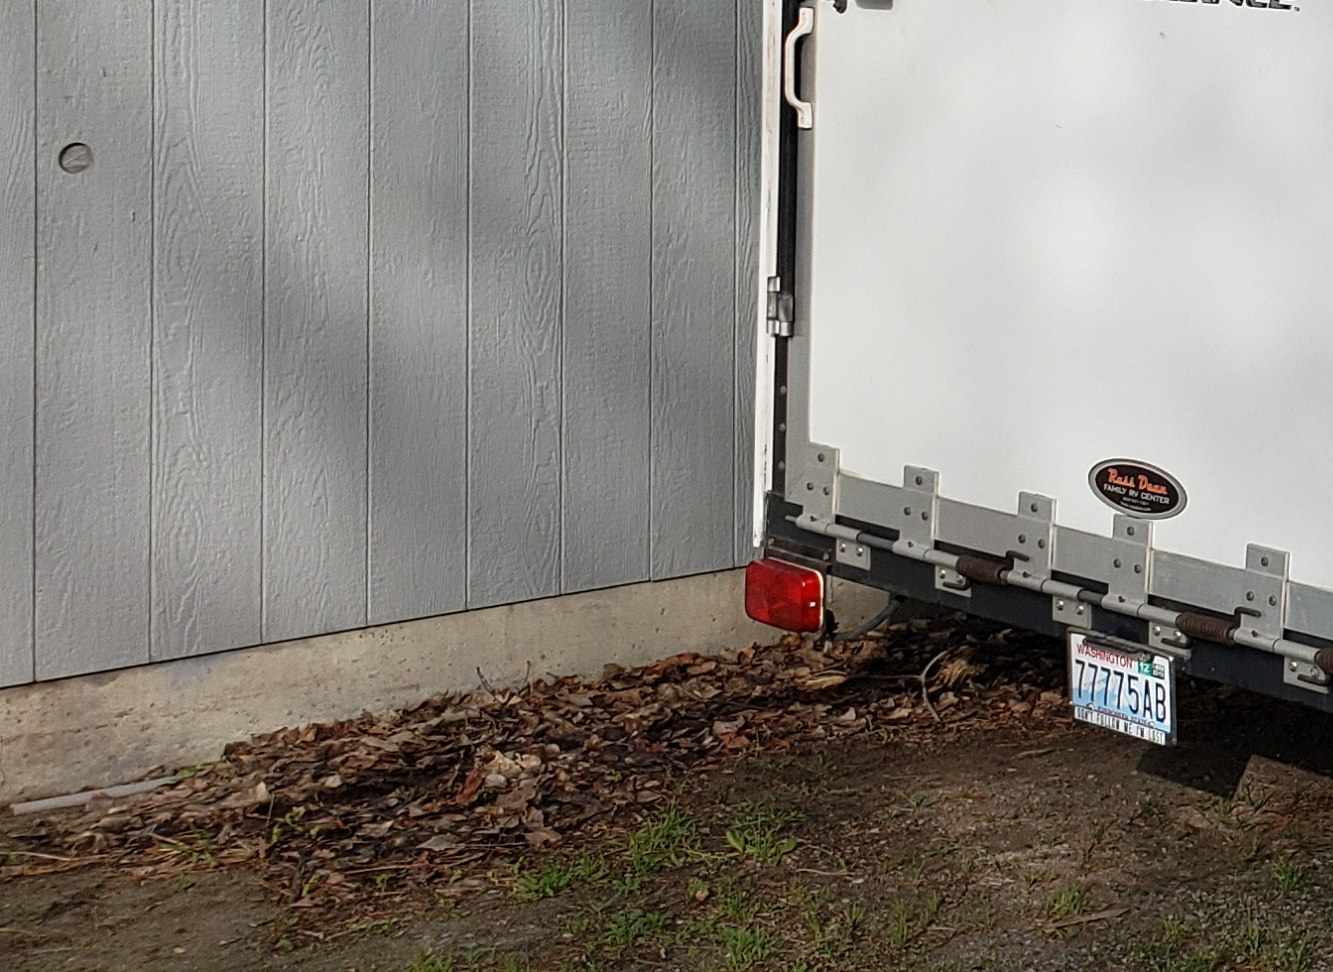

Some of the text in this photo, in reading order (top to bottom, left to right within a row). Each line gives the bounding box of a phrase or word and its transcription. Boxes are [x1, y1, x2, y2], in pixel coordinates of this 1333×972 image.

[1103, 483, 1127, 495] FAMILY
[1128, 489, 1139, 498] RV
[1141, 492, 1170, 505] CENTER
[1076, 644, 1133, 668] WASHINGTON
[1075, 658, 1166, 722] 77775AB
[1096, 711, 1120, 730] FOLLOW
[1124, 721, 1133, 734] ME
[1148, 728, 1164, 745] LOST
